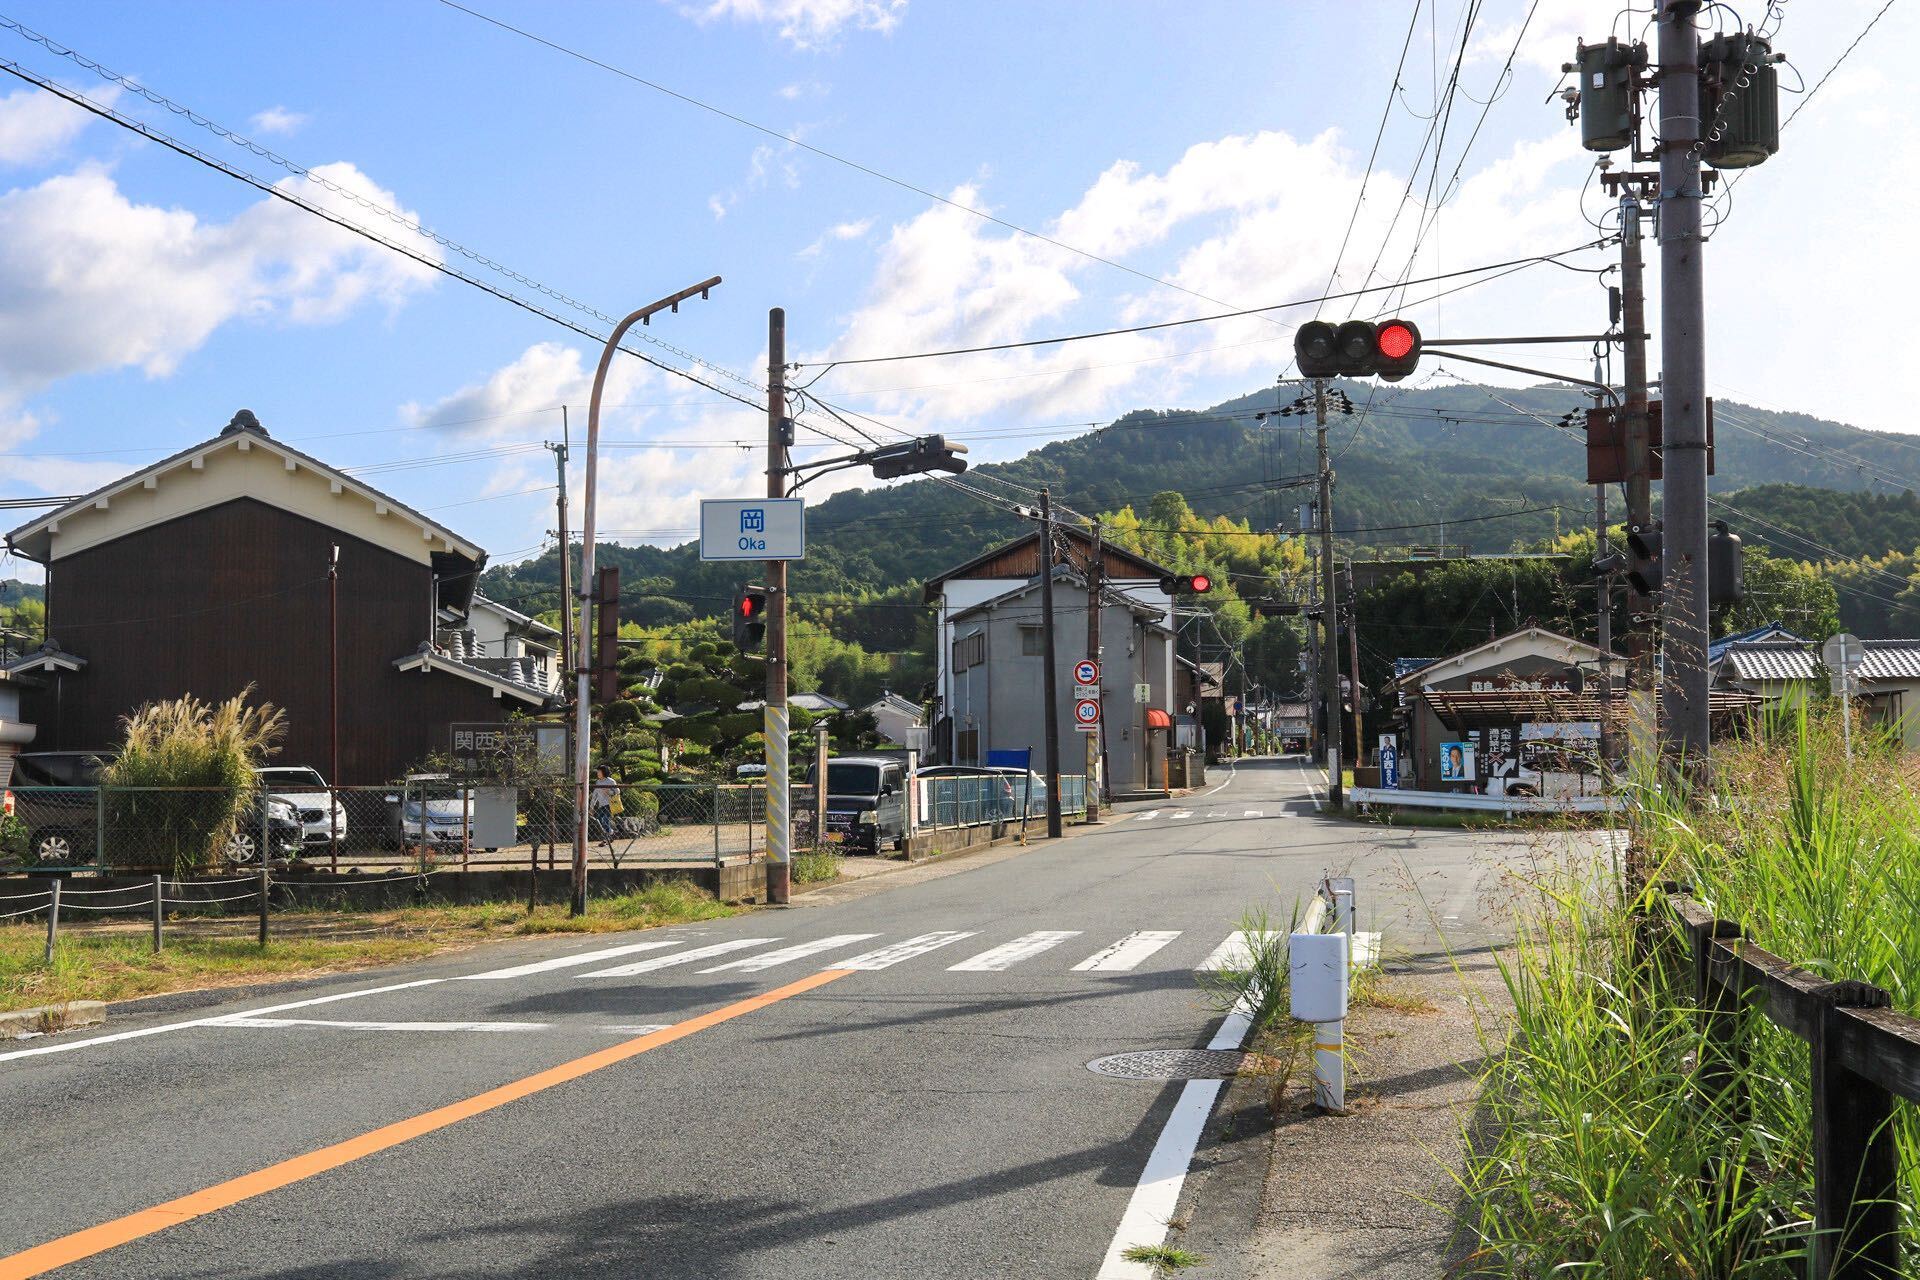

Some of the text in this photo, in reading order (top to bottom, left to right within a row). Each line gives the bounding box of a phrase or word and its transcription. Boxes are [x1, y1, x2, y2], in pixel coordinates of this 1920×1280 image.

[741, 509, 764, 533] 岡
[738, 537, 766, 550] Oka
[1081, 706, 1095, 717] 30
[454, 731, 535, 751] 関西大学
[1488, 728, 1500, 753] 通行禁止
